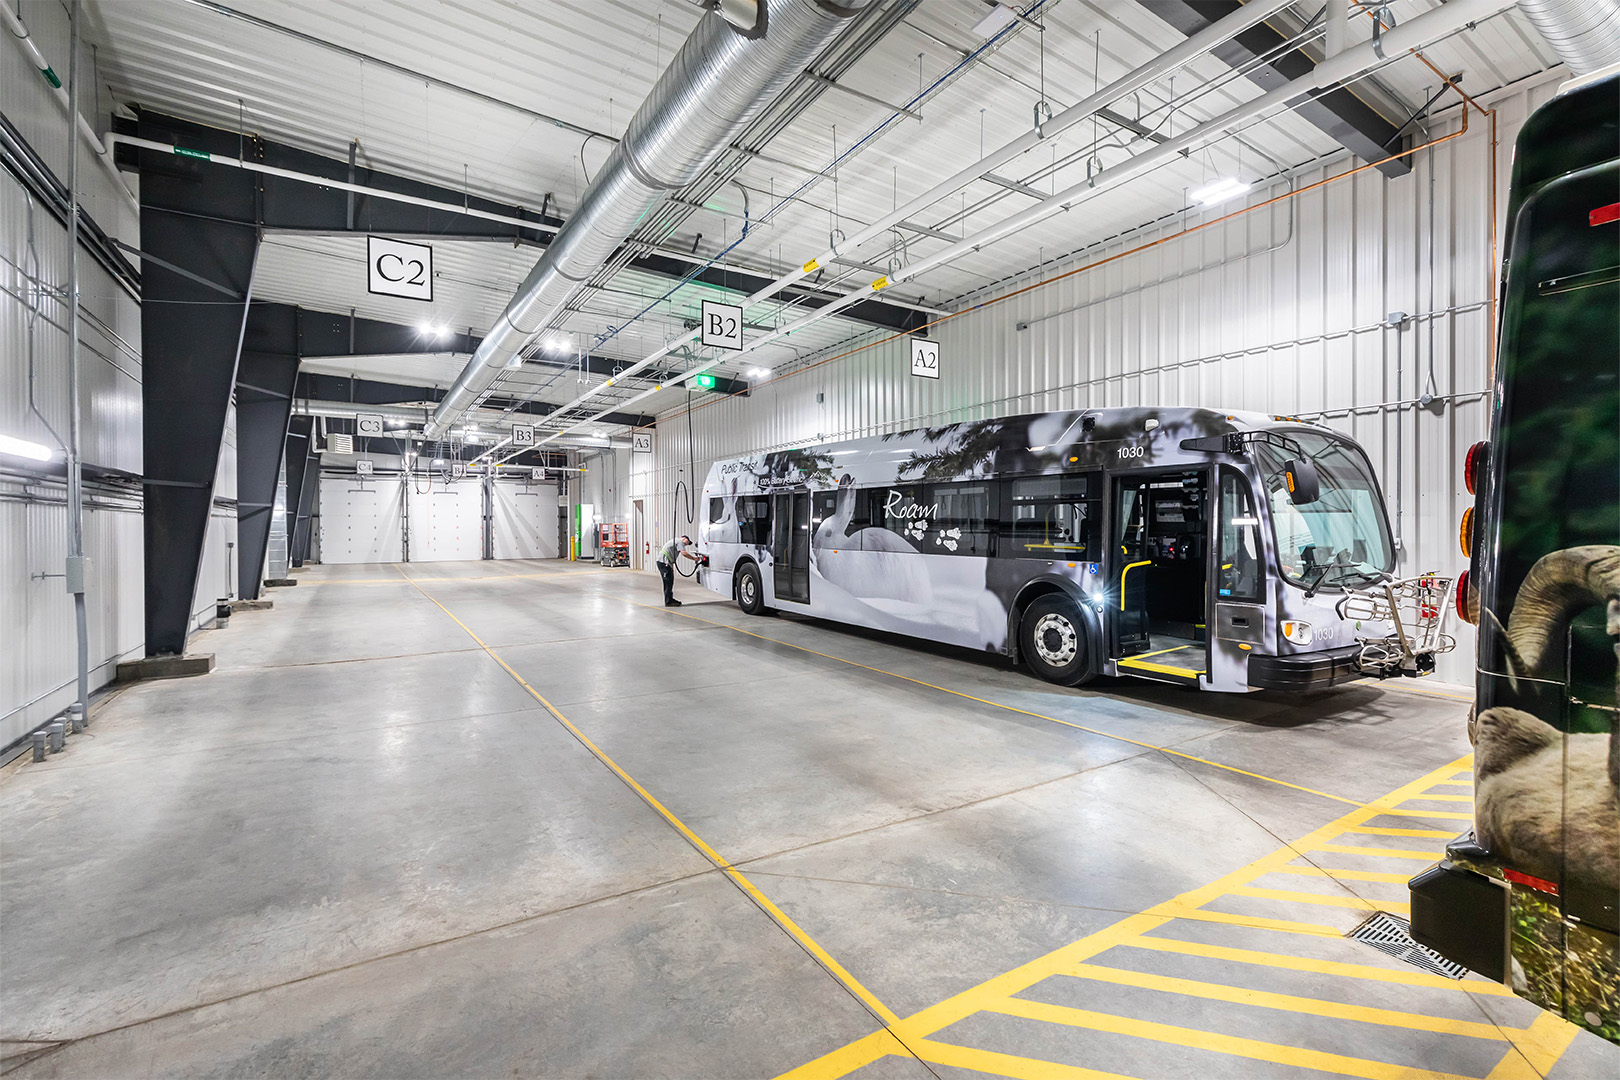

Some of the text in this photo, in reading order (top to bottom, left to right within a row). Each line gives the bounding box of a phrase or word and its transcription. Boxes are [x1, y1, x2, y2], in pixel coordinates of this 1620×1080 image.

[376, 253, 426, 287] C2
[708, 312, 738, 339] B2
[914, 349, 937, 370] A2
[360, 419, 380, 432] C3
[516, 430, 532, 442] B3
[634, 438, 650, 449] A3
[1117, 446, 1144, 459] 1030
[883, 489, 939, 521] Roam
[1314, 626, 1334, 641] 1030
